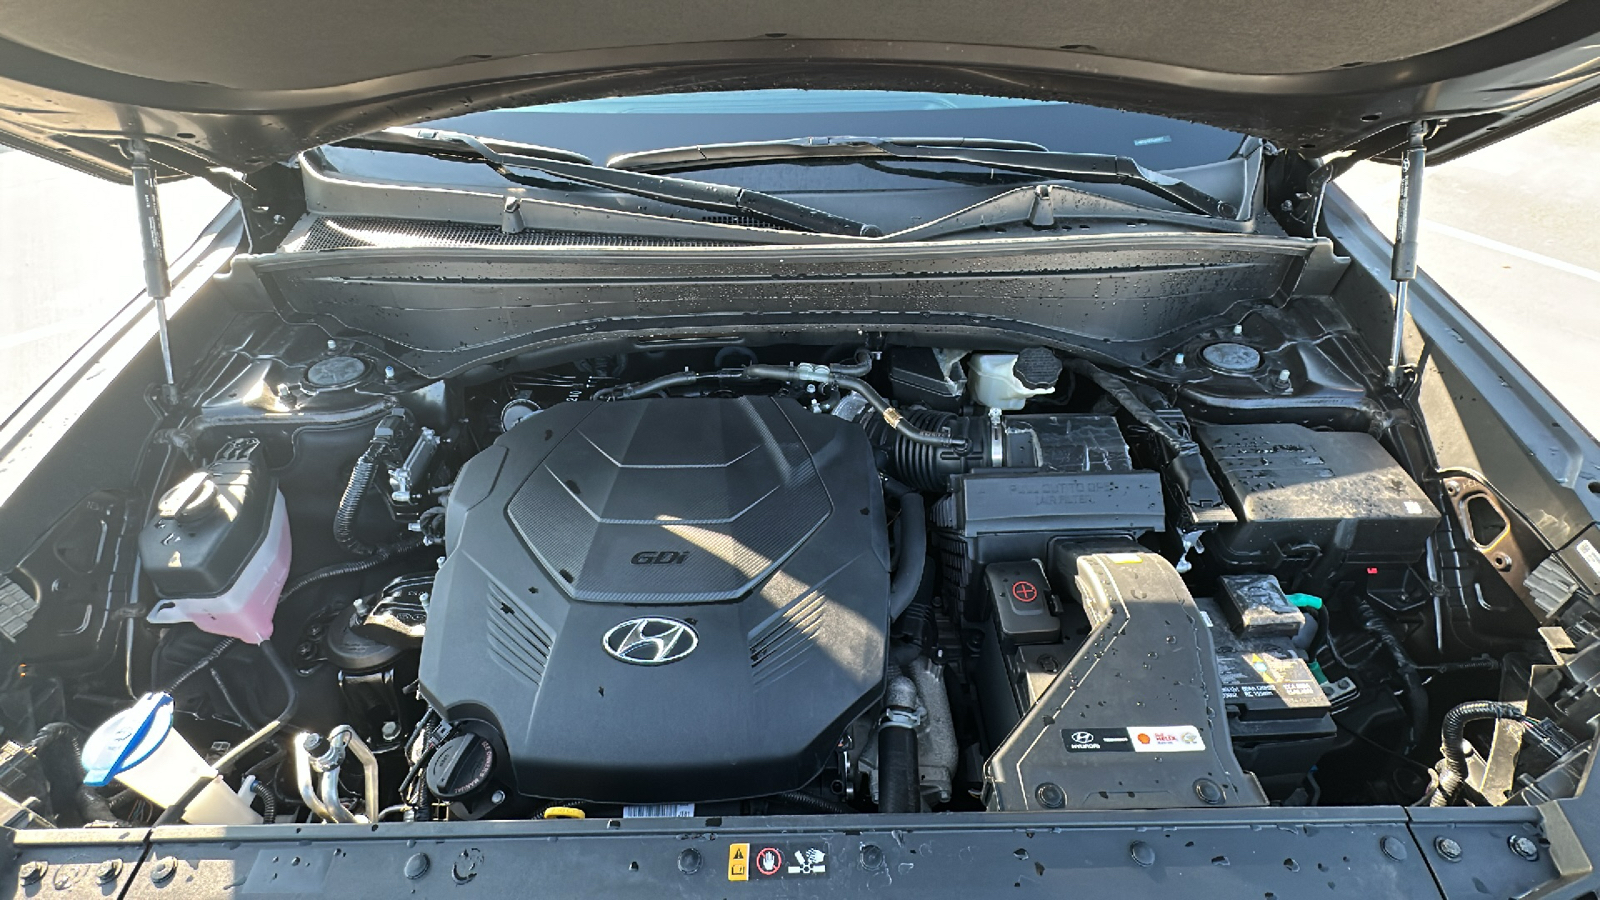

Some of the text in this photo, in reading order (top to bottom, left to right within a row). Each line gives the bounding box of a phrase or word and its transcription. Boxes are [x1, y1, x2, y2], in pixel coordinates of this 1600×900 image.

[1042, 483, 1066, 494] OUT
[1068, 482, 1085, 493] TO
[630, 550, 690, 565] GDi
[454, 777, 480, 794] MANUAL
